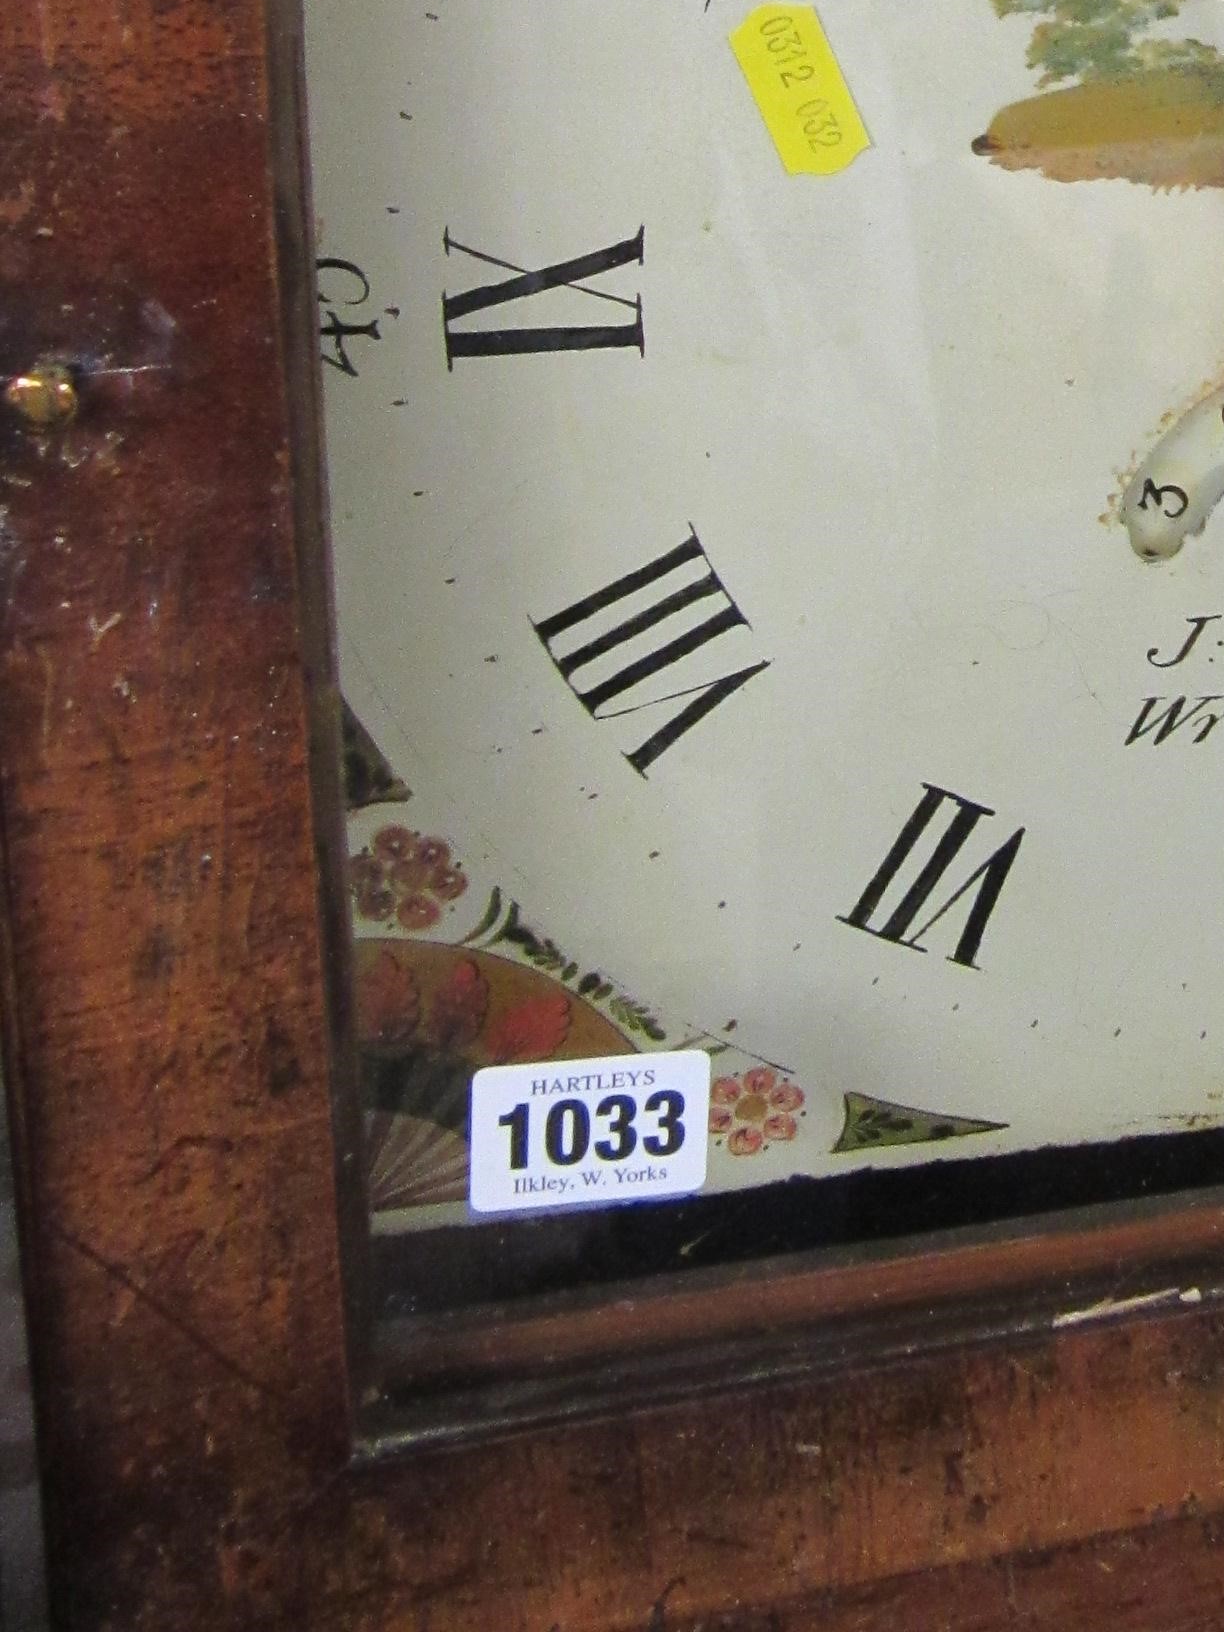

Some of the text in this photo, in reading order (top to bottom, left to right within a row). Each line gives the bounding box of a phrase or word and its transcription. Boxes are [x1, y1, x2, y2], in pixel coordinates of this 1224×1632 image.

[759, 16, 843, 154] 0312 032
[442, 225, 646, 373] IX
[1138, 477, 1189, 520] 3
[835, 782, 1026, 970] VII
[530, 1069, 656, 1096] HARTLEYS
[498, 1089, 687, 1170] 1033
[614, 1166, 668, 1184] Yorks
